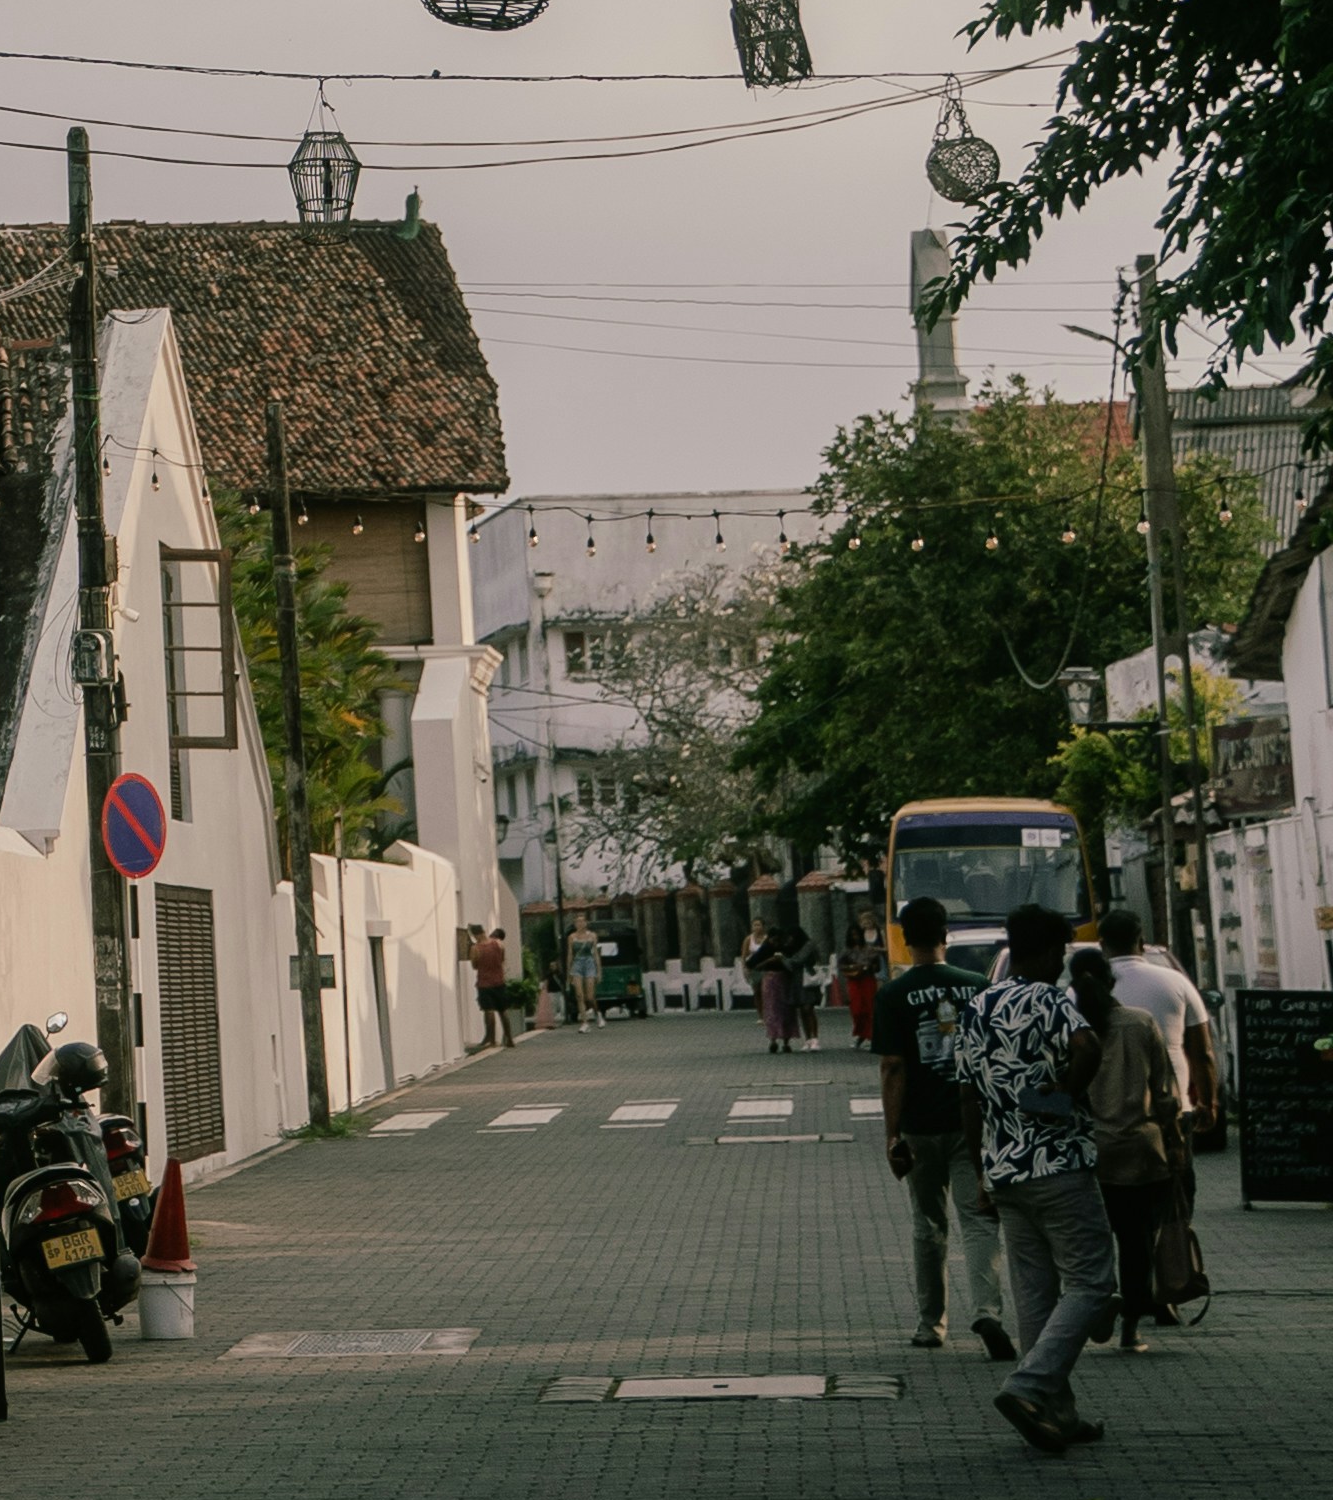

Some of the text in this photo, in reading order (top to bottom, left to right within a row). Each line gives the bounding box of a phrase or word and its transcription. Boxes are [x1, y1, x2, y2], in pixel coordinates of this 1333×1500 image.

[907, 985, 947, 1006] GIVE
[61, 1231, 91, 1250] BGR
[47, 1245, 97, 1262] SP 4122
